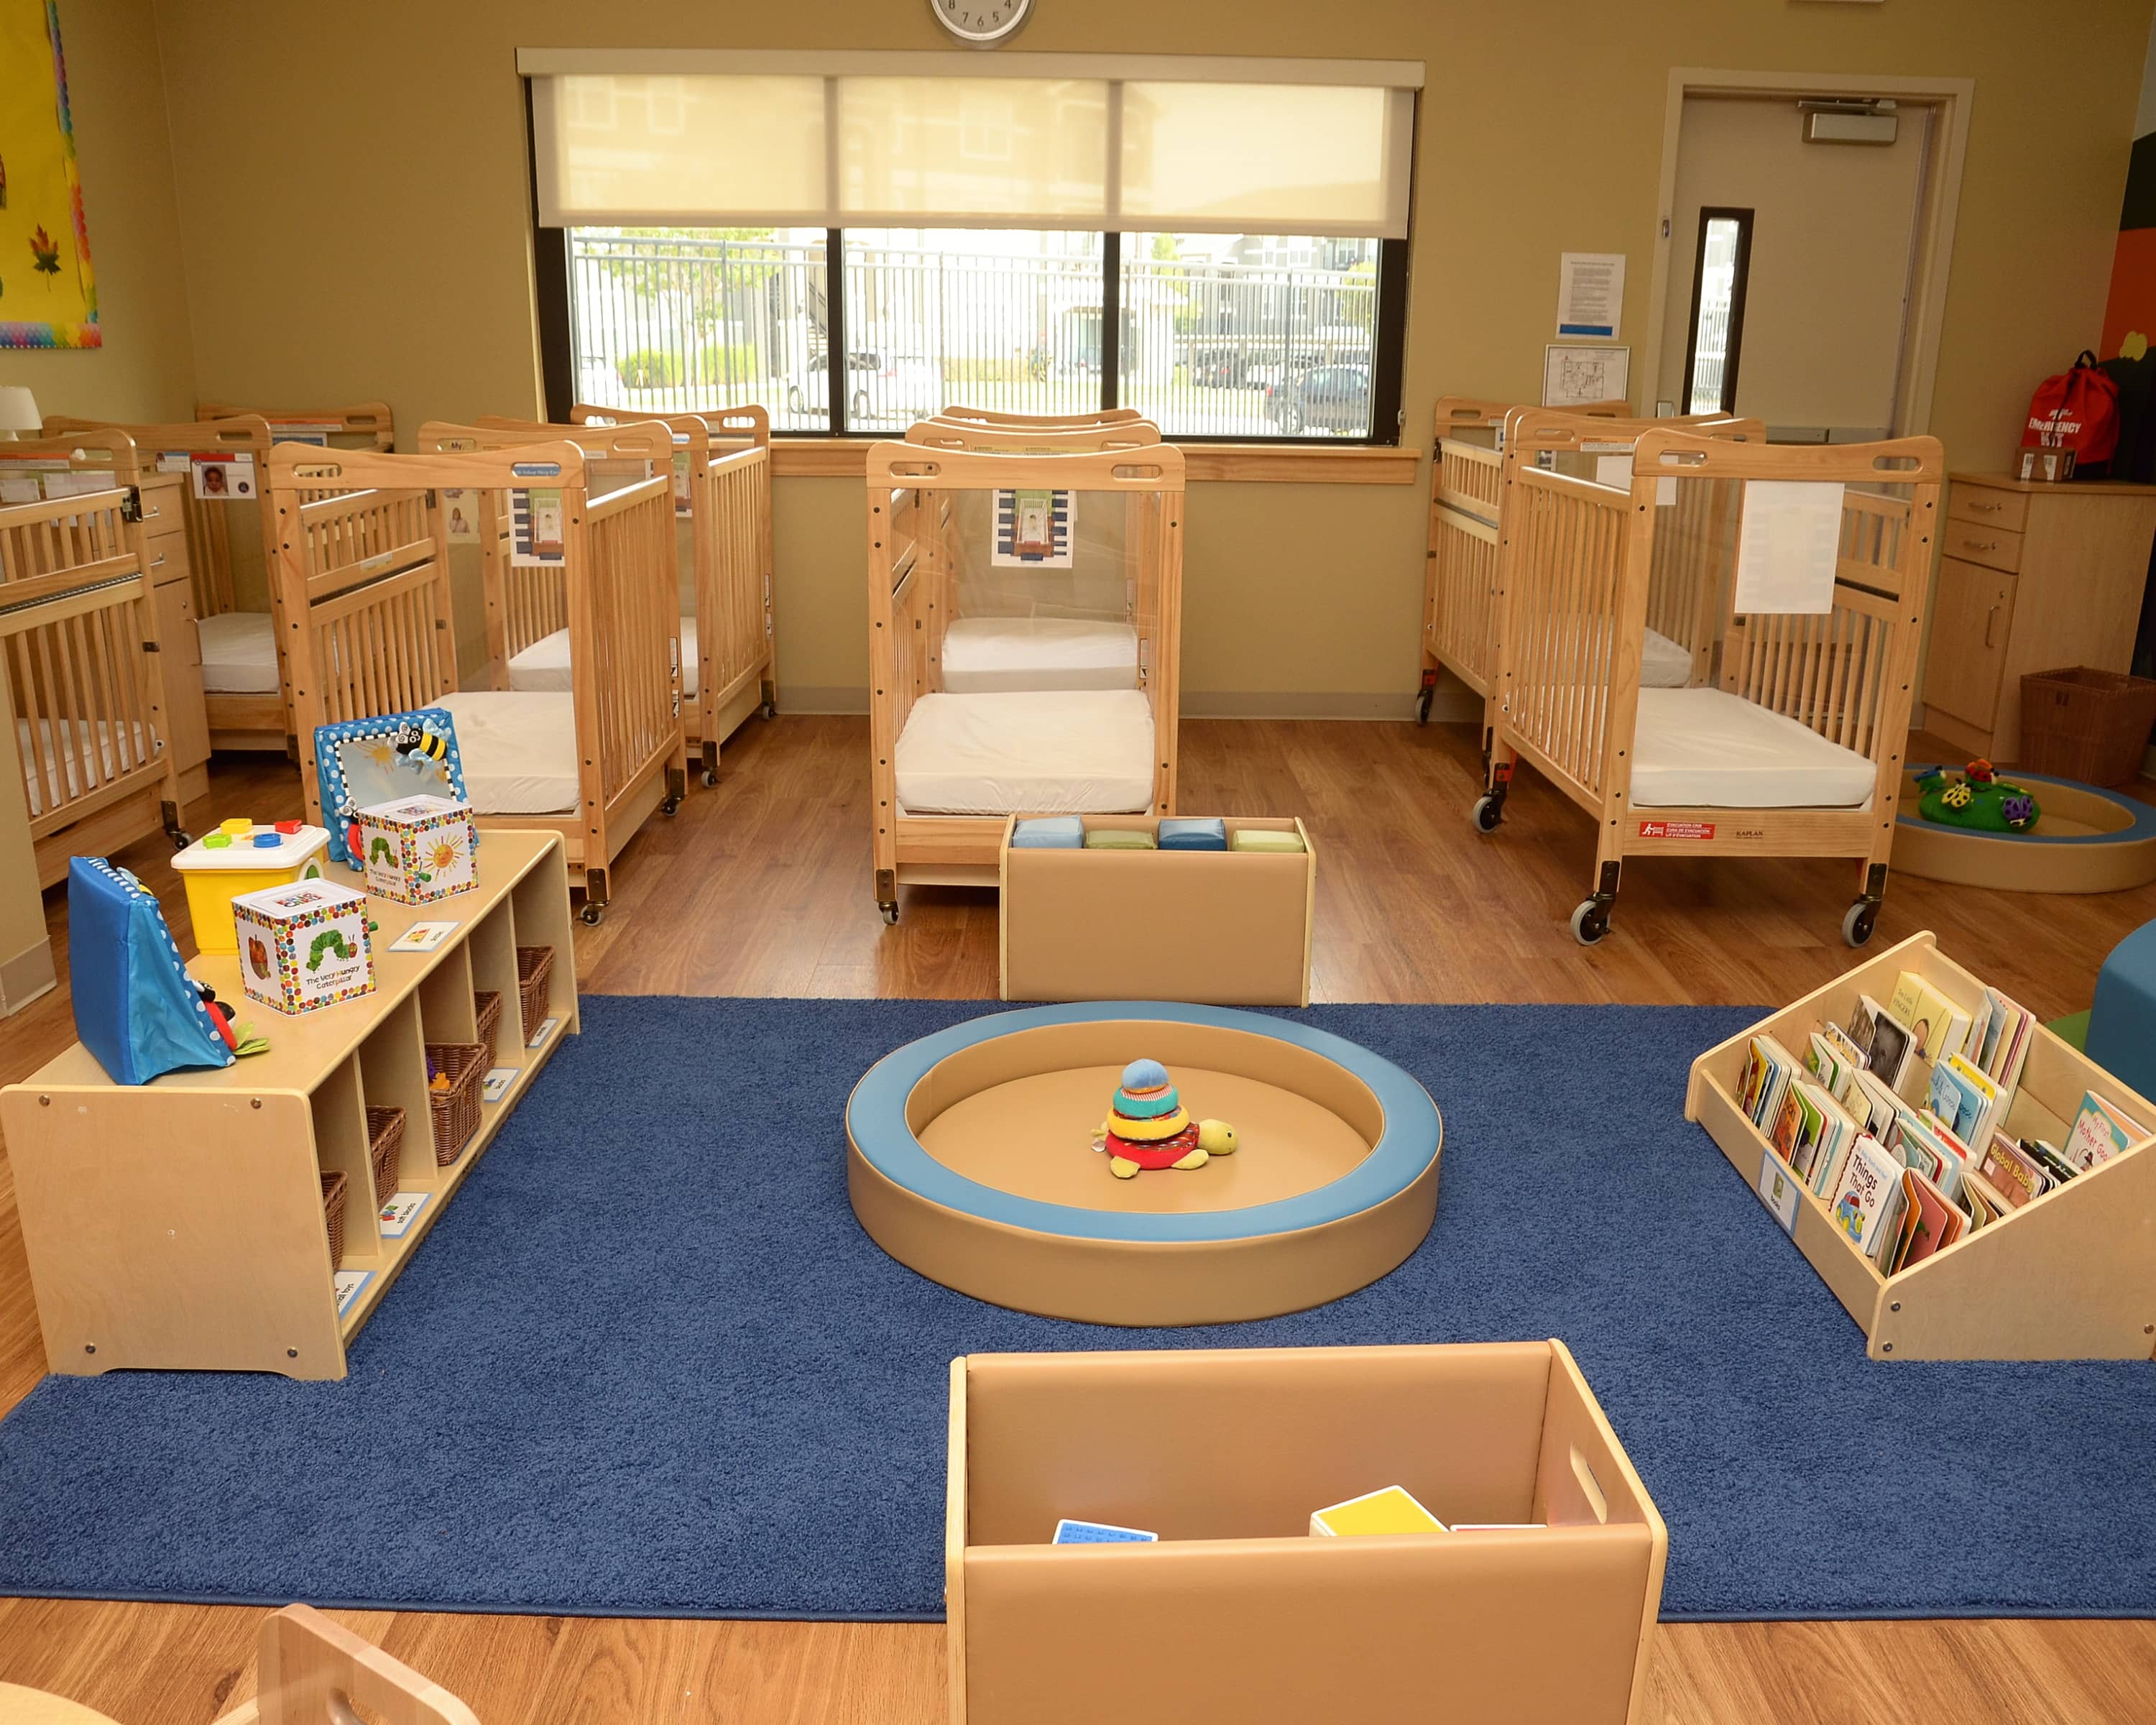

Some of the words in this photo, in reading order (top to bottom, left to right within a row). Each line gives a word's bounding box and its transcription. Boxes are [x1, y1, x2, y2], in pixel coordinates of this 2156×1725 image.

[949, 0, 955, 9] 8
[962, 12, 969, 24] 7
[977, 16, 984, 27] 6
[992, 12, 999, 22] 5
[320, 972, 336, 981] Very
[336, 965, 360, 976] Hungry
[316, 975, 352, 990] Caterpillar
[2078, 1119, 2097, 1148] Mother
[2096, 1144, 2110, 1162] Goo
[1852, 1153, 1878, 1190] Things
[1990, 1143, 2014, 1173] Global
[2013, 1165, 2035, 1194] Baby
[1850, 1172, 1865, 1196] That
[1864, 1190, 1875, 1208] Go
[341, 1283, 354, 1294] toys
